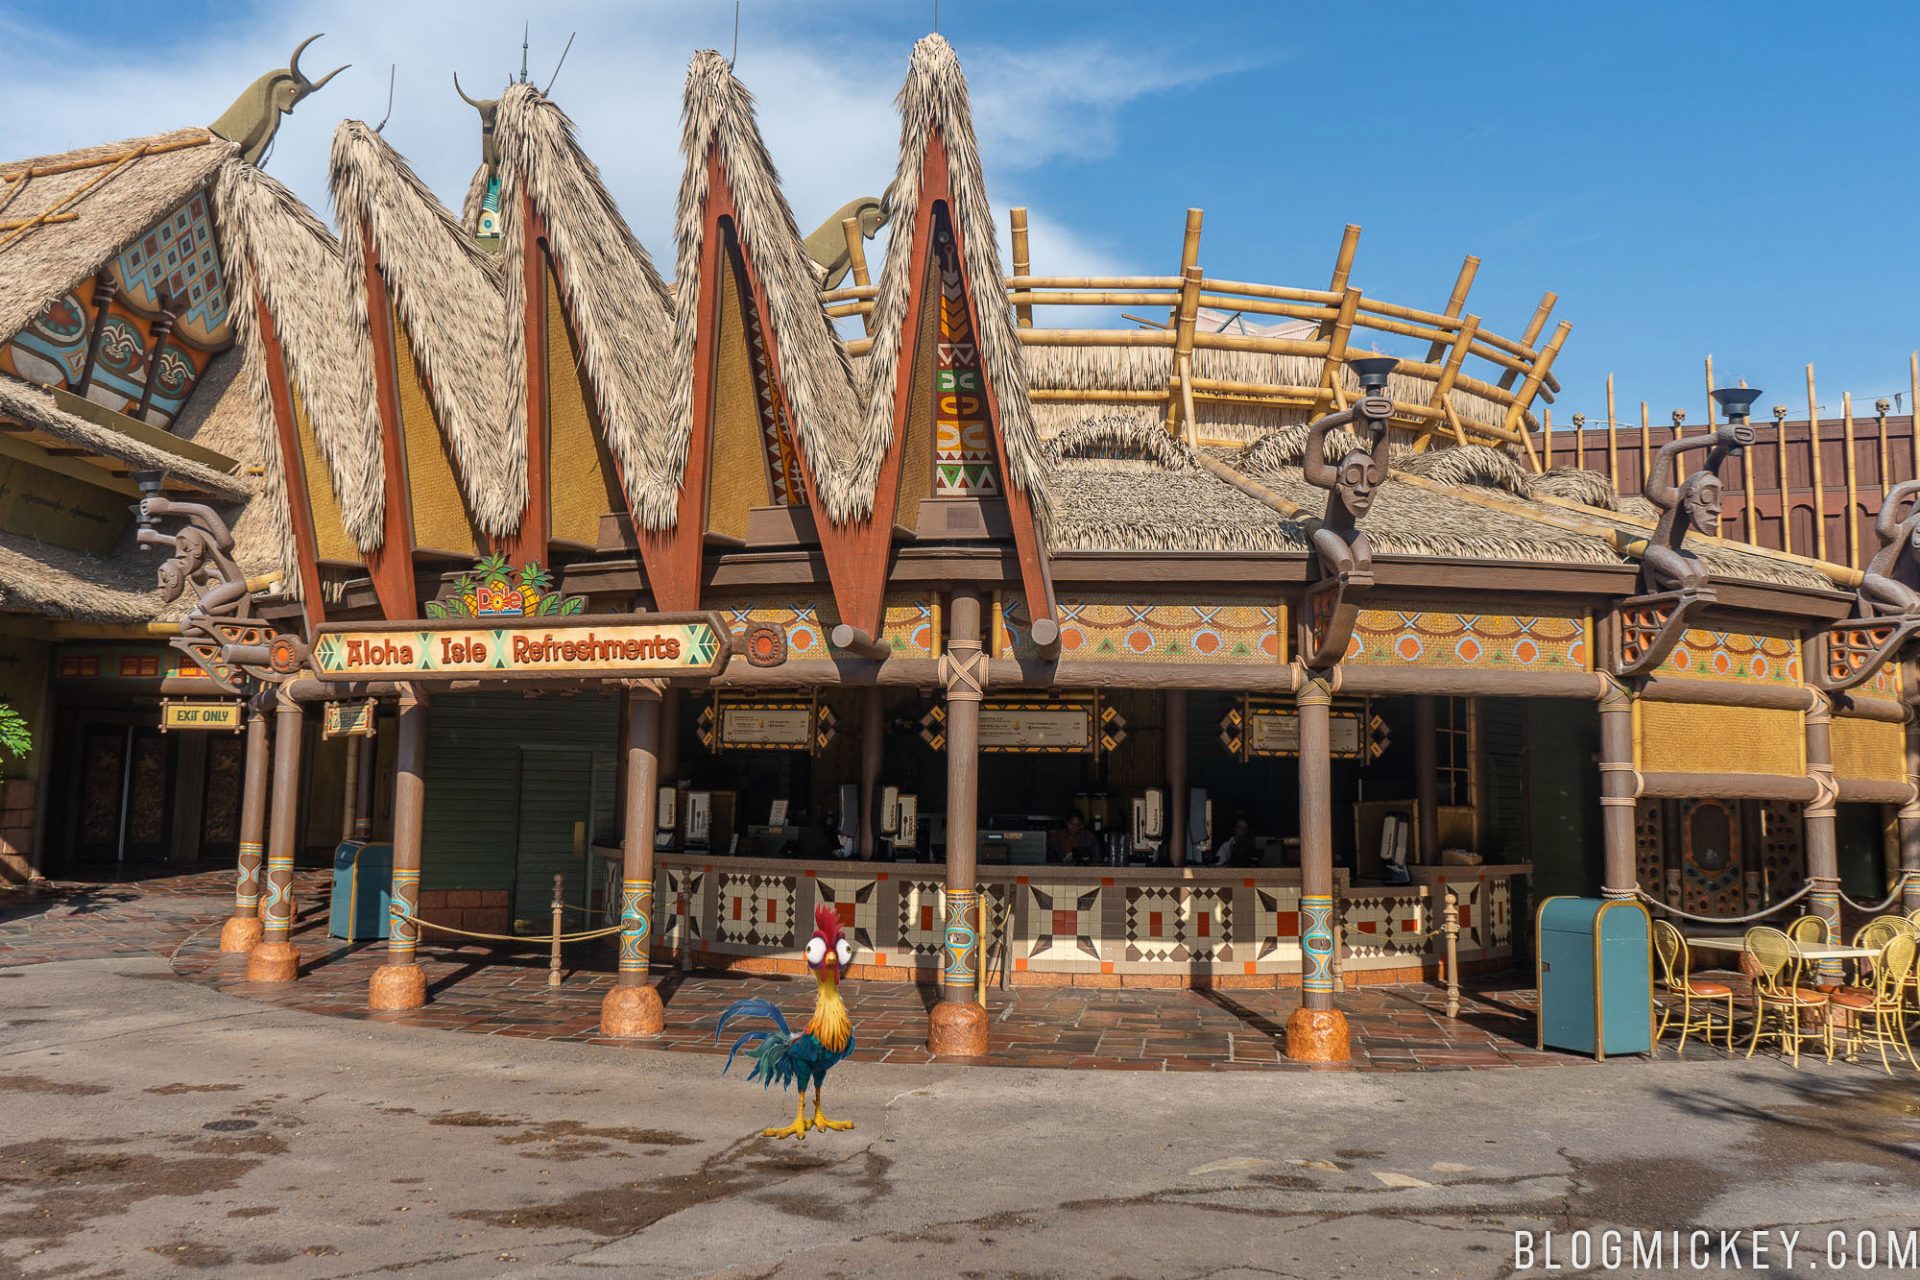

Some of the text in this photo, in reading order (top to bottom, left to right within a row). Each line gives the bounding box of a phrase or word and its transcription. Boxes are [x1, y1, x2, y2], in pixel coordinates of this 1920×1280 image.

[477, 586, 523, 611] Dole
[346, 634, 681, 667] Aloha Isle Refreshments
[202, 710, 229, 722] ONLY
